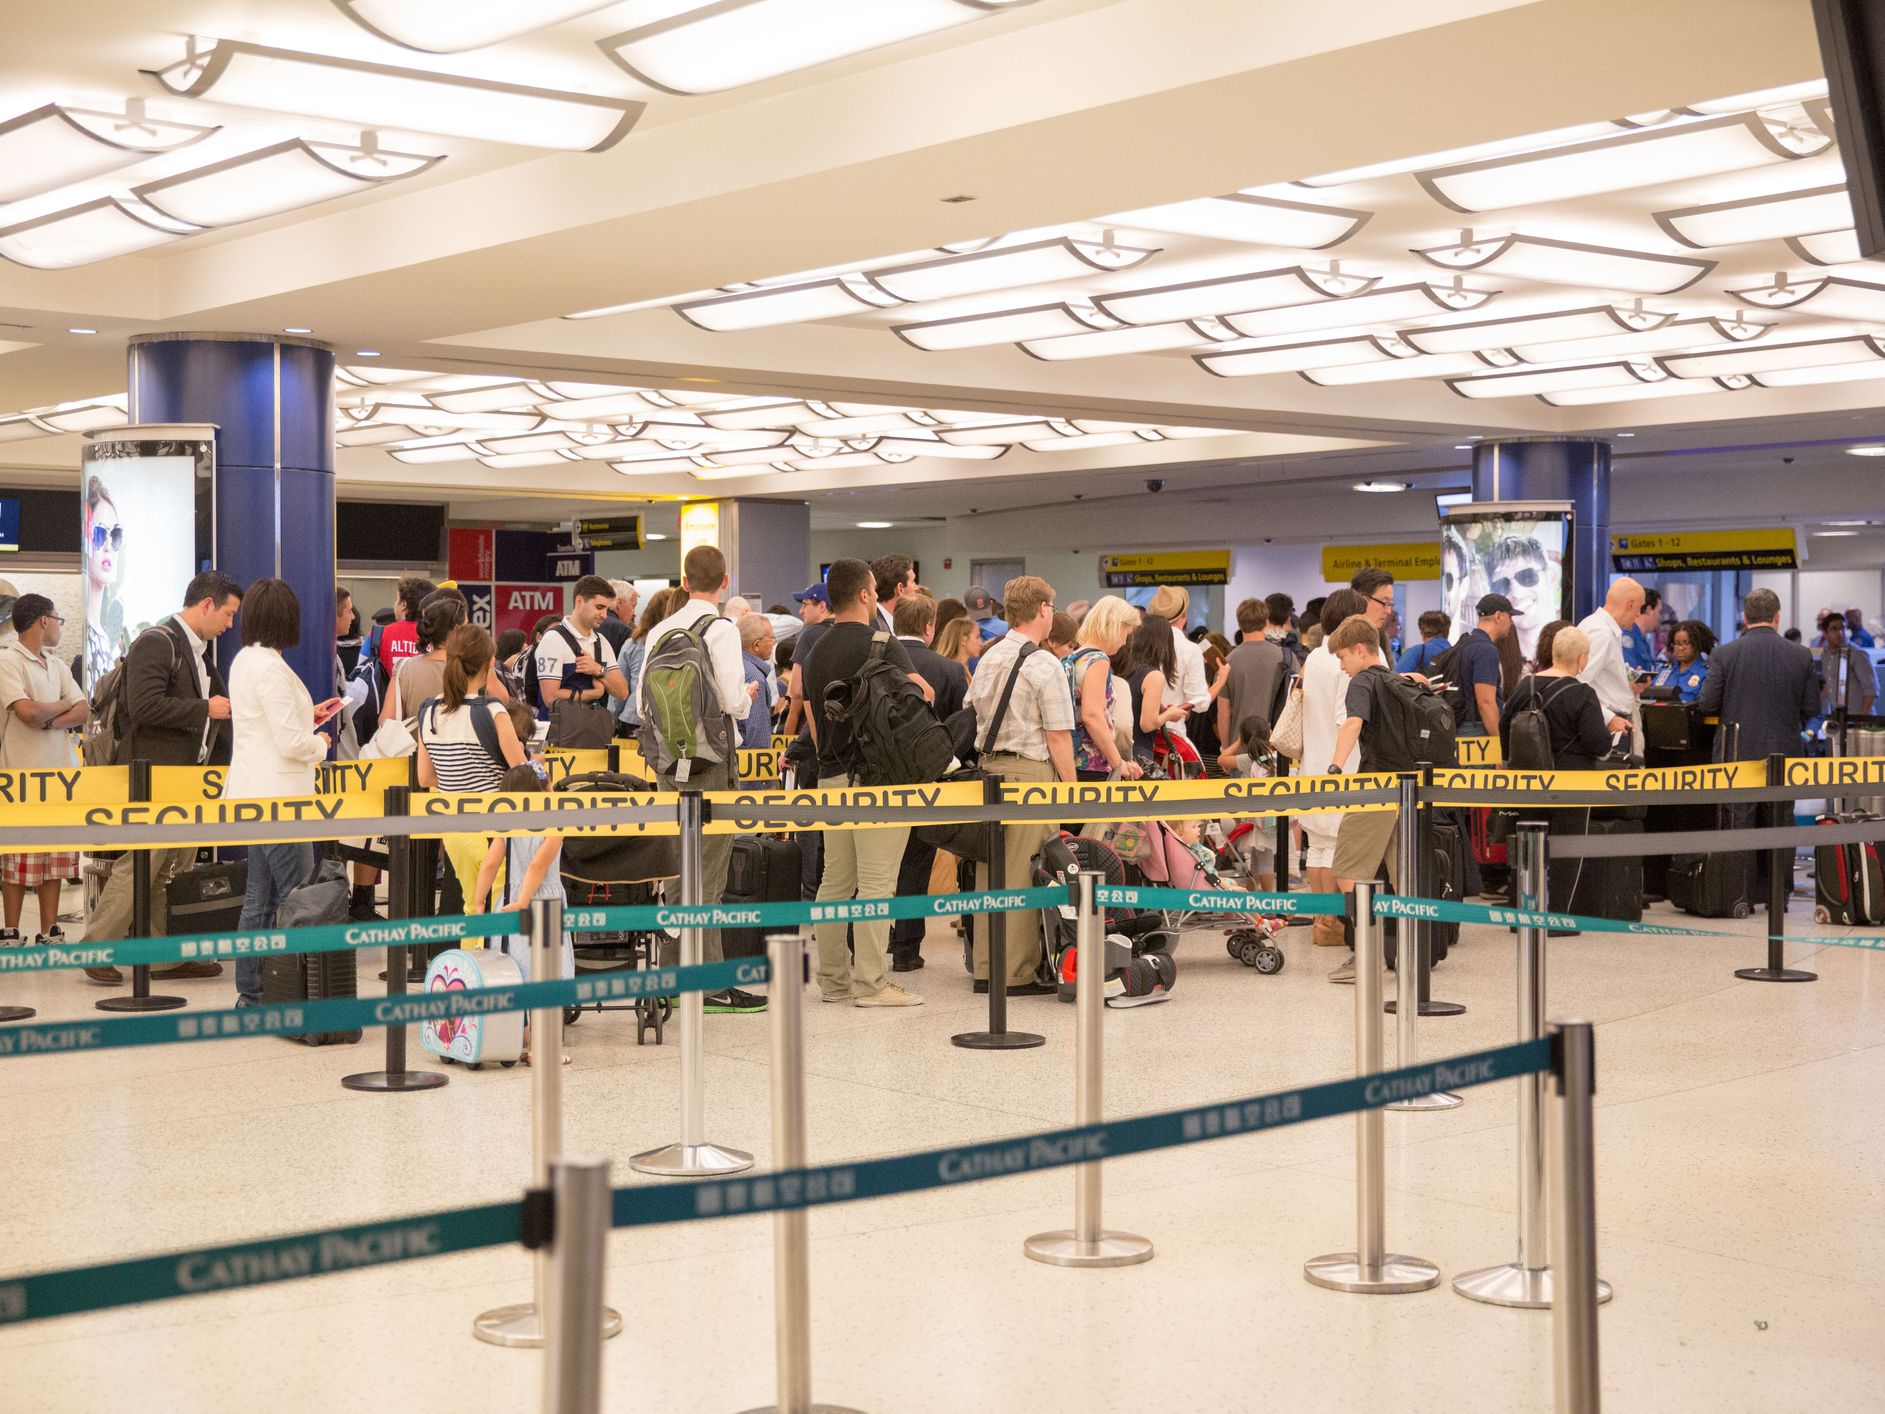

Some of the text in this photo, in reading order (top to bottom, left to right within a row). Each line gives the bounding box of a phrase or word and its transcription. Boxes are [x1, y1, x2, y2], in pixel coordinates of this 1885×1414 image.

[1631, 538, 1656, 548] Gates
[1658, 538, 1663, 547] 1
[1671, 538, 1681, 547] 12
[555, 560, 580, 577] ATM
[1333, 559, 1362, 569] Airline
[1374, 558, 1412, 568] Terminal
[1686, 556, 1740, 568] Restaurants
[1743, 556, 1750, 565] &
[1752, 554, 1793, 567] Lounges
[1154, 574, 1191, 583] Restaurants
[1191, 573, 1197, 581] &
[1198, 572, 1225, 582] Lounges
[508, 591, 554, 611] ATM
[538, 657, 558, 673] 87
[733, 787, 941, 830] SECURITY
[934, 895, 1026, 913] CATHAY PACIFIC
[1189, 893, 1297, 912] CATHAY PACIFIC
[1391, 900, 1439, 918] PACIFIC
[656, 908, 761, 926] CATHAY PACIFIC
[345, 922, 466, 944] CATHAY PACIFIC
[48, 948, 115, 966] PACIFIC
[375, 992, 515, 1021] CATHAY PACIFIC
[18, 1028, 100, 1050] PACIFIC
[1365, 1058, 1495, 1104] CATHAY PACIFIC
[938, 1132, 1107, 1183] CATHAY PACIFIC
[176, 1221, 440, 1293] CATHAY PACIFIC
